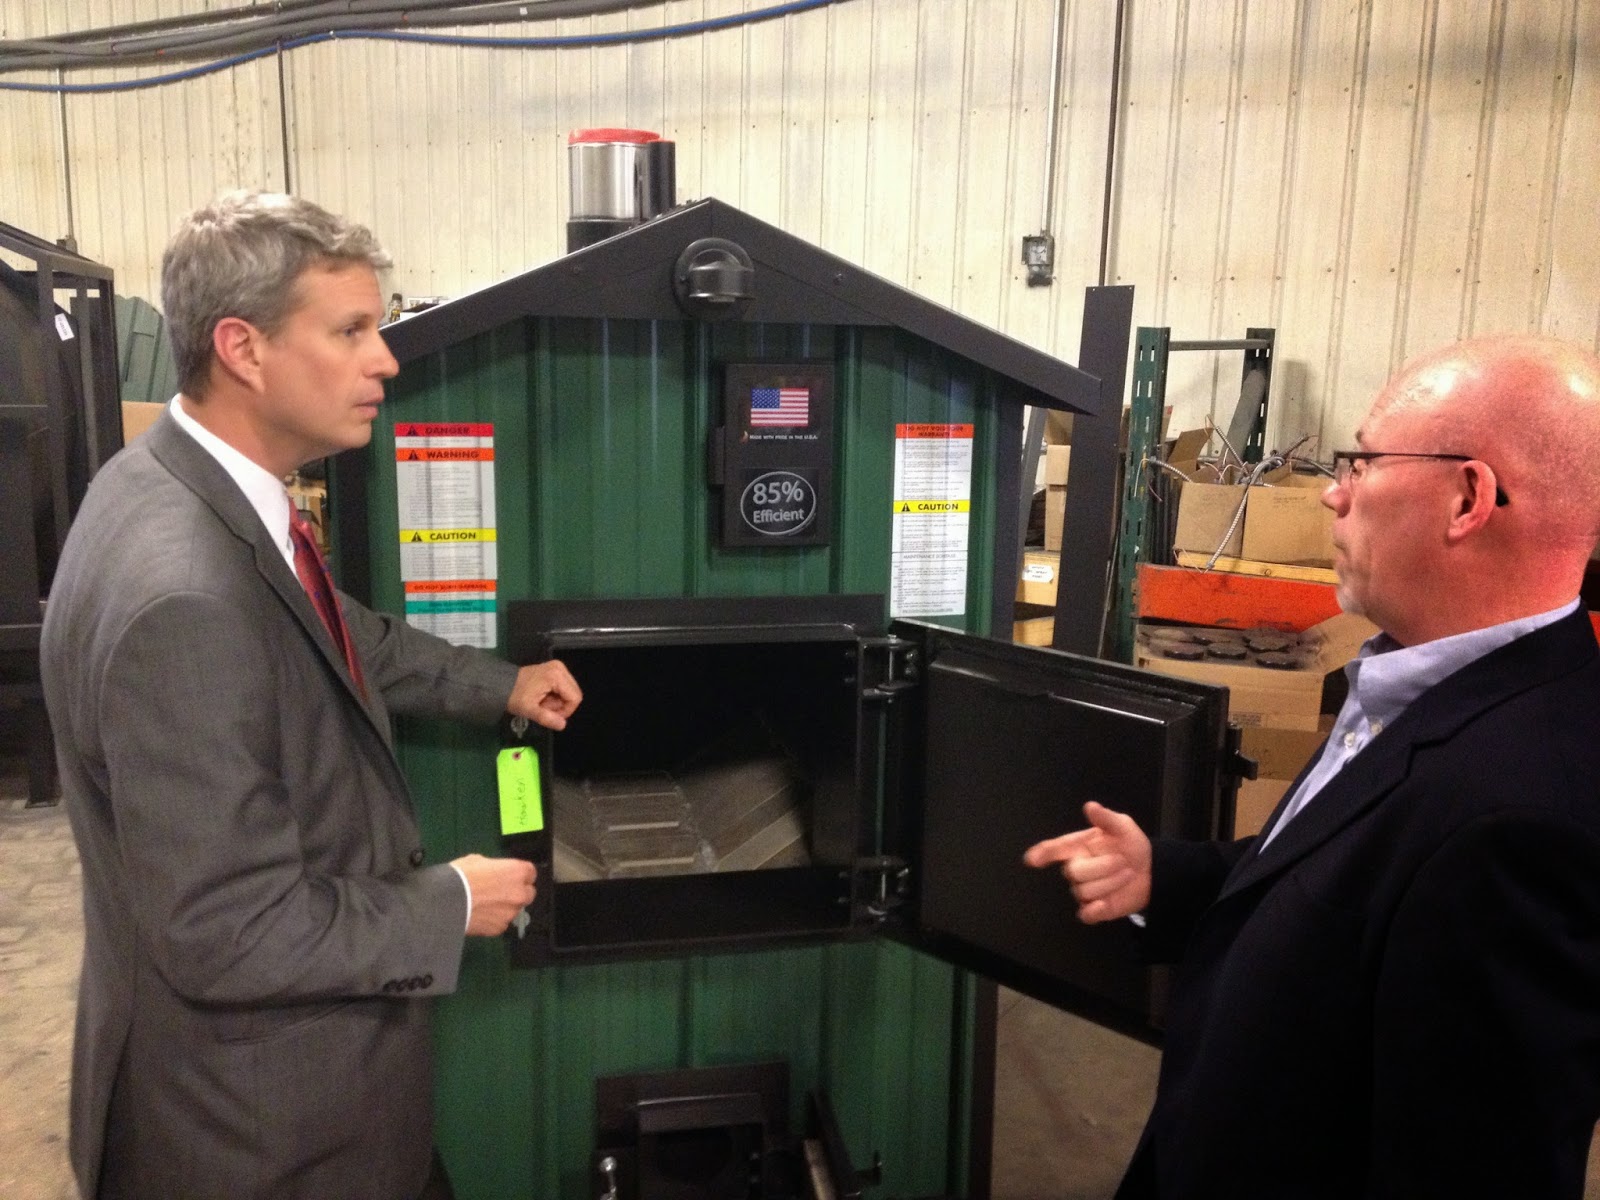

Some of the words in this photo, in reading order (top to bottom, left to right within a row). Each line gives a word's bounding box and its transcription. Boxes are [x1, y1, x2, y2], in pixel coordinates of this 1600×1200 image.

[425, 427, 470, 435] DANGER
[426, 450, 479, 459] WARNING
[752, 480, 804, 505] 85%
[918, 503, 959, 511] CAUTION
[753, 508, 805, 524] Efficient
[430, 532, 476, 541] CAUTION
